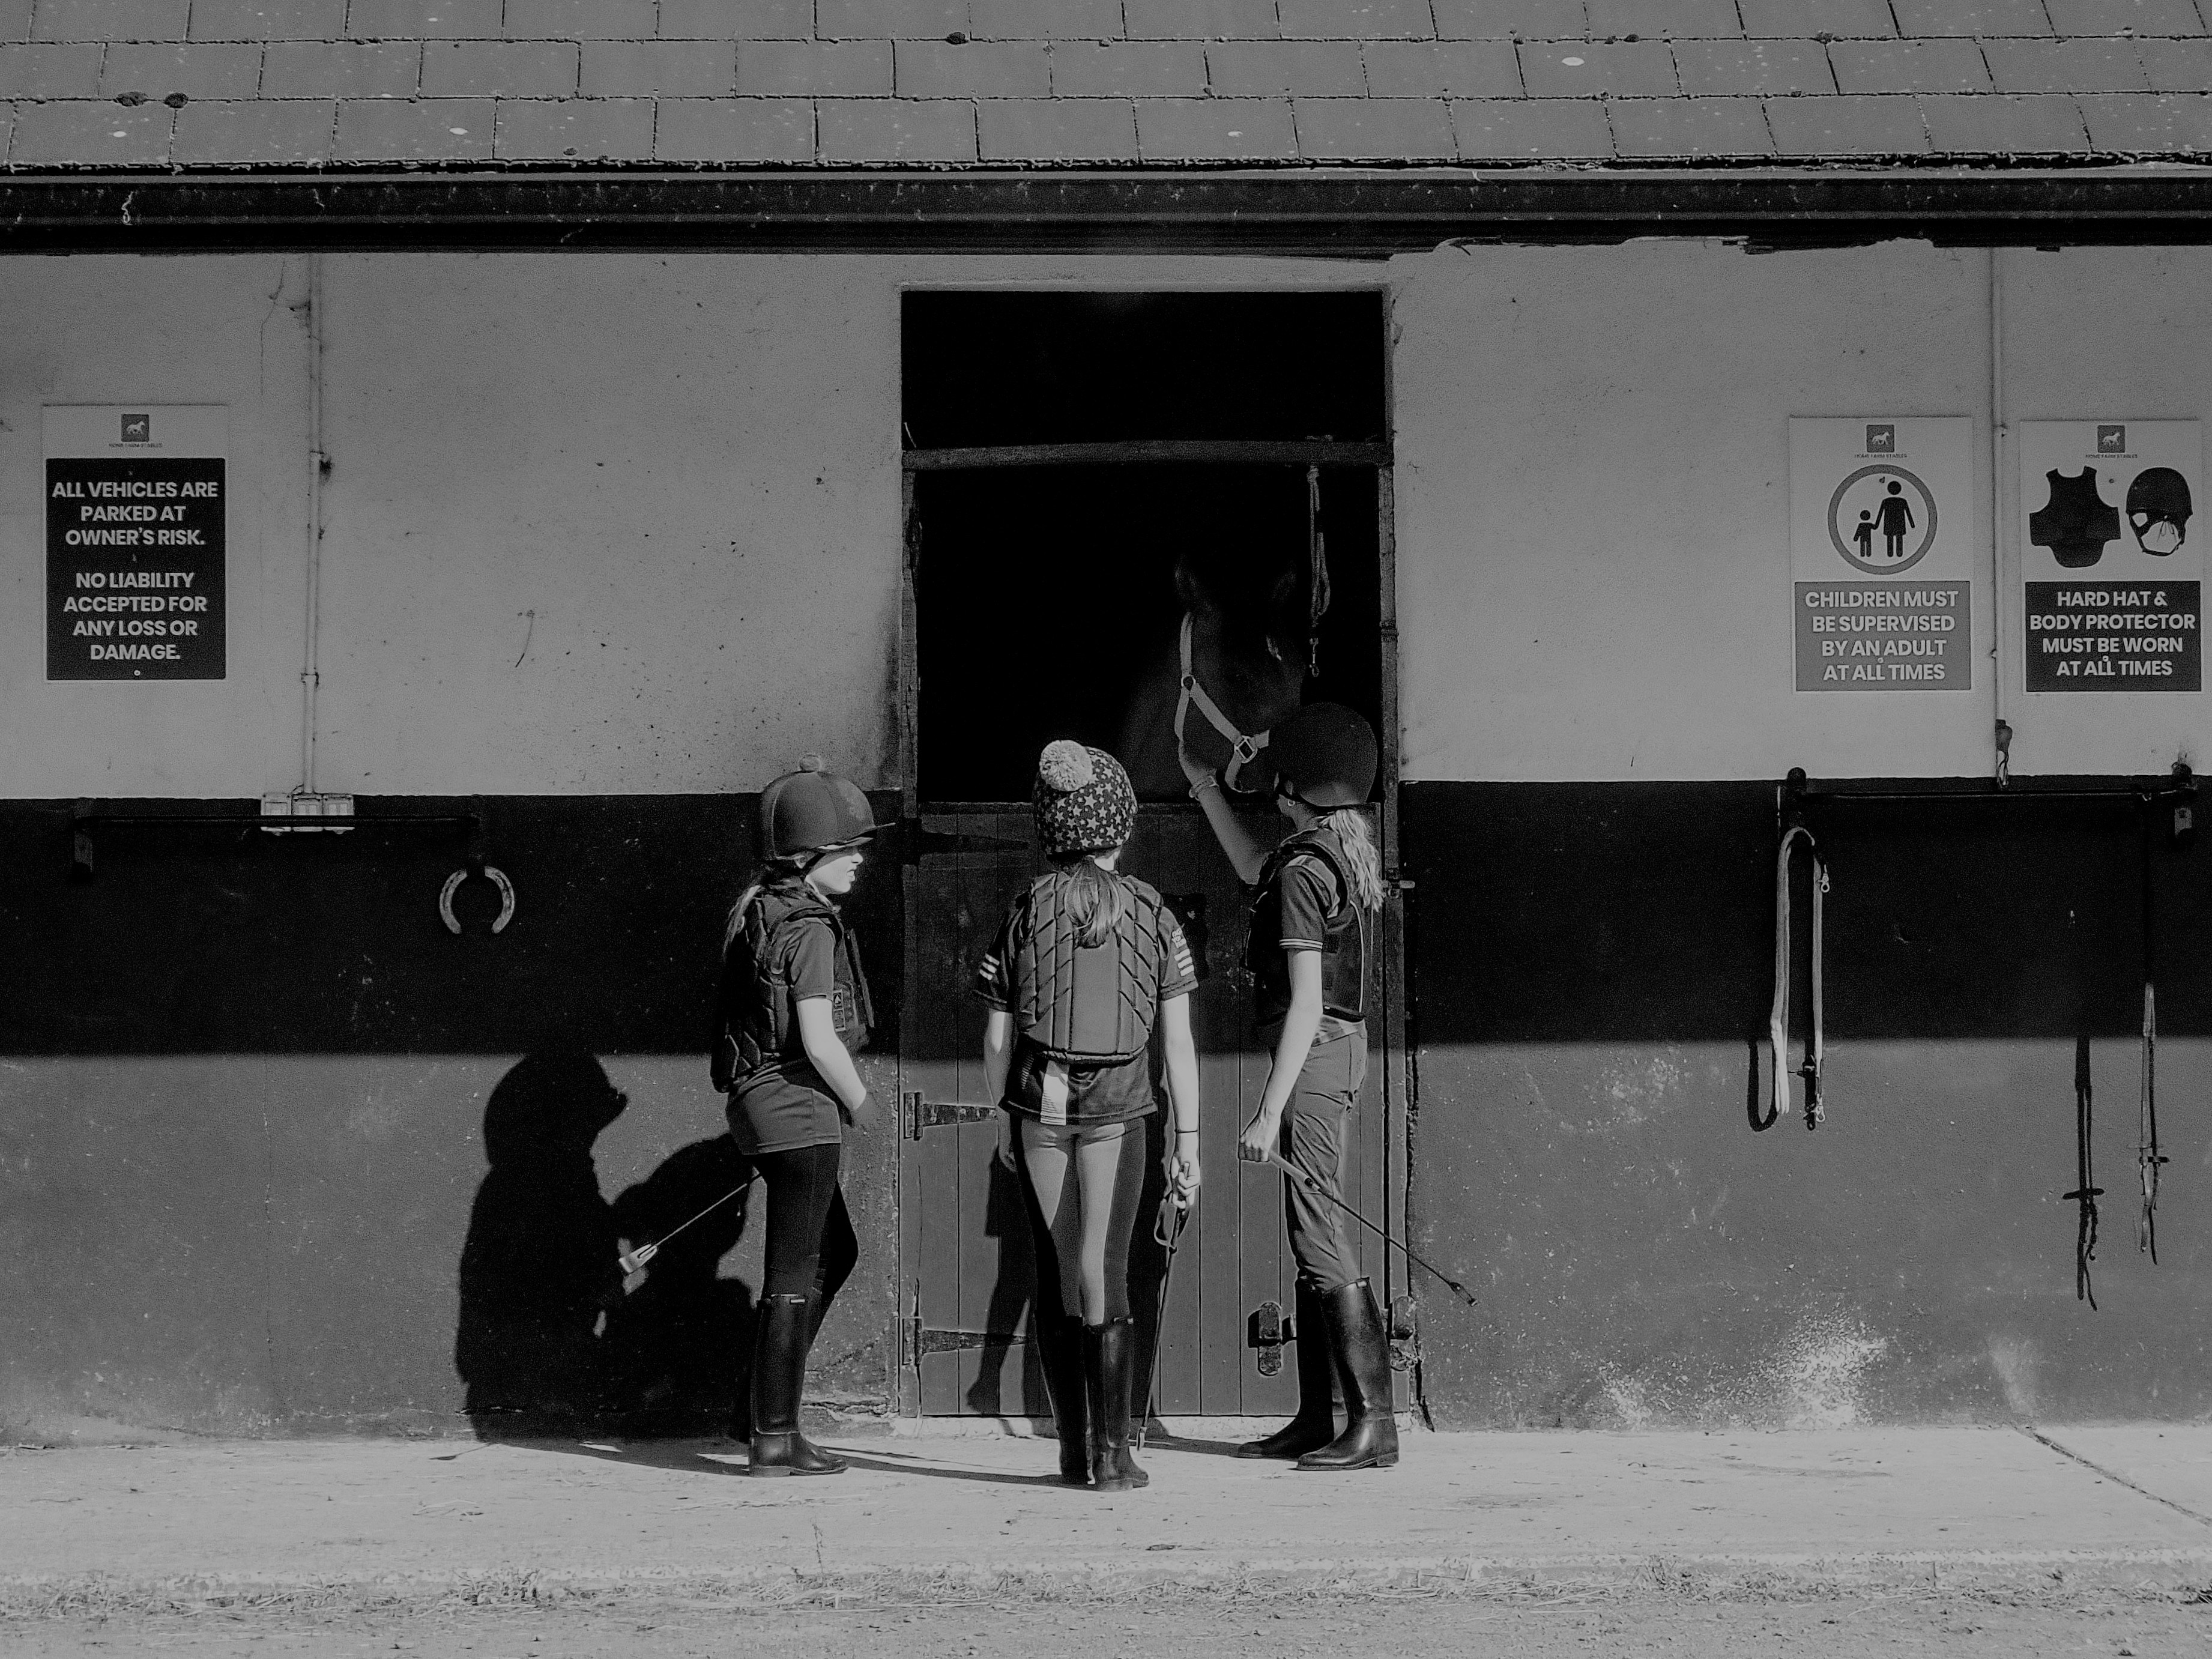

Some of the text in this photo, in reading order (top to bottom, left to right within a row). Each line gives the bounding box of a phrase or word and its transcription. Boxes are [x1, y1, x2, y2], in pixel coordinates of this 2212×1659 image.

[52, 482, 218, 498] ALL VEHICLES ARE
[81, 506, 187, 521] PARKED AT
[65, 527, 205, 545] OWNER'S RISK.
[76, 572, 195, 588] NO LIABILITY
[63, 596, 207, 612] ACCEPTED FOR
[1805, 591, 1959, 608] CHILDREN MUST
[2057, 591, 2168, 606] HARD HAT &
[72, 620, 198, 636] ANY LOSS OR
[1813, 615, 1955, 632] BE SUPERVISED
[2030, 614, 2196, 630] BODY PROTECTOR
[90, 644, 181, 660] DAMAGE.
[1822, 639, 1947, 656] BY AN ADULT
[2043, 637, 2183, 653] MUST BE WORN
[1823, 664, 1945, 681] AT ALL TIMES
[2056, 660, 2173, 676] AT ALL TIMES
